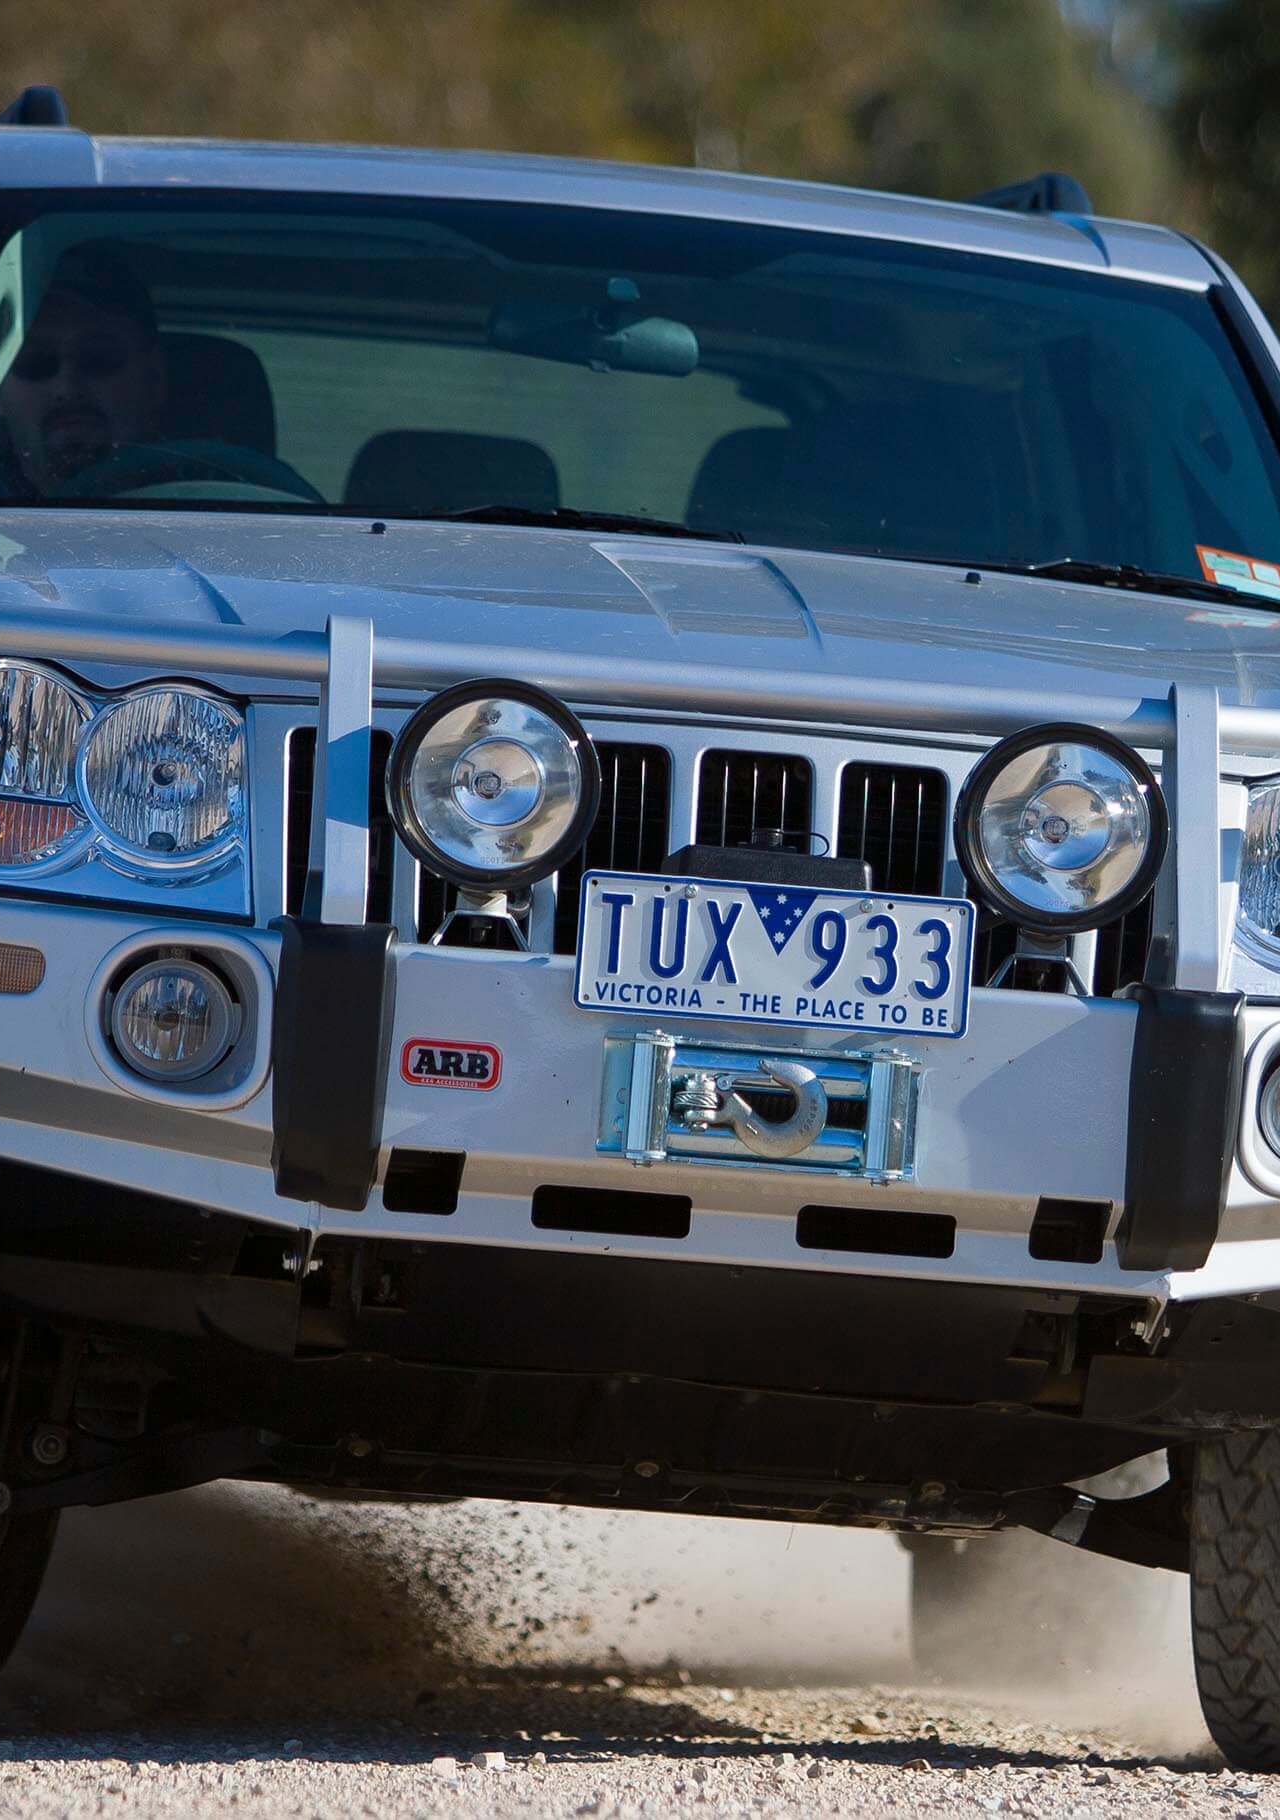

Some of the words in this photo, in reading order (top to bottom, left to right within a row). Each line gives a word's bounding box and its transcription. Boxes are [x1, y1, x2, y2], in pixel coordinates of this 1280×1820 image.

[601, 892, 744, 984] TUX
[809, 909, 953, 1000] 933
[595, 981, 703, 1008] VICTORIA
[740, 992, 781, 1014] THE
[795, 997, 865, 1020] PLACE
[878, 1003, 908, 1024] TO
[922, 1007, 948, 1028] BE
[412, 1047, 490, 1080] ARB
